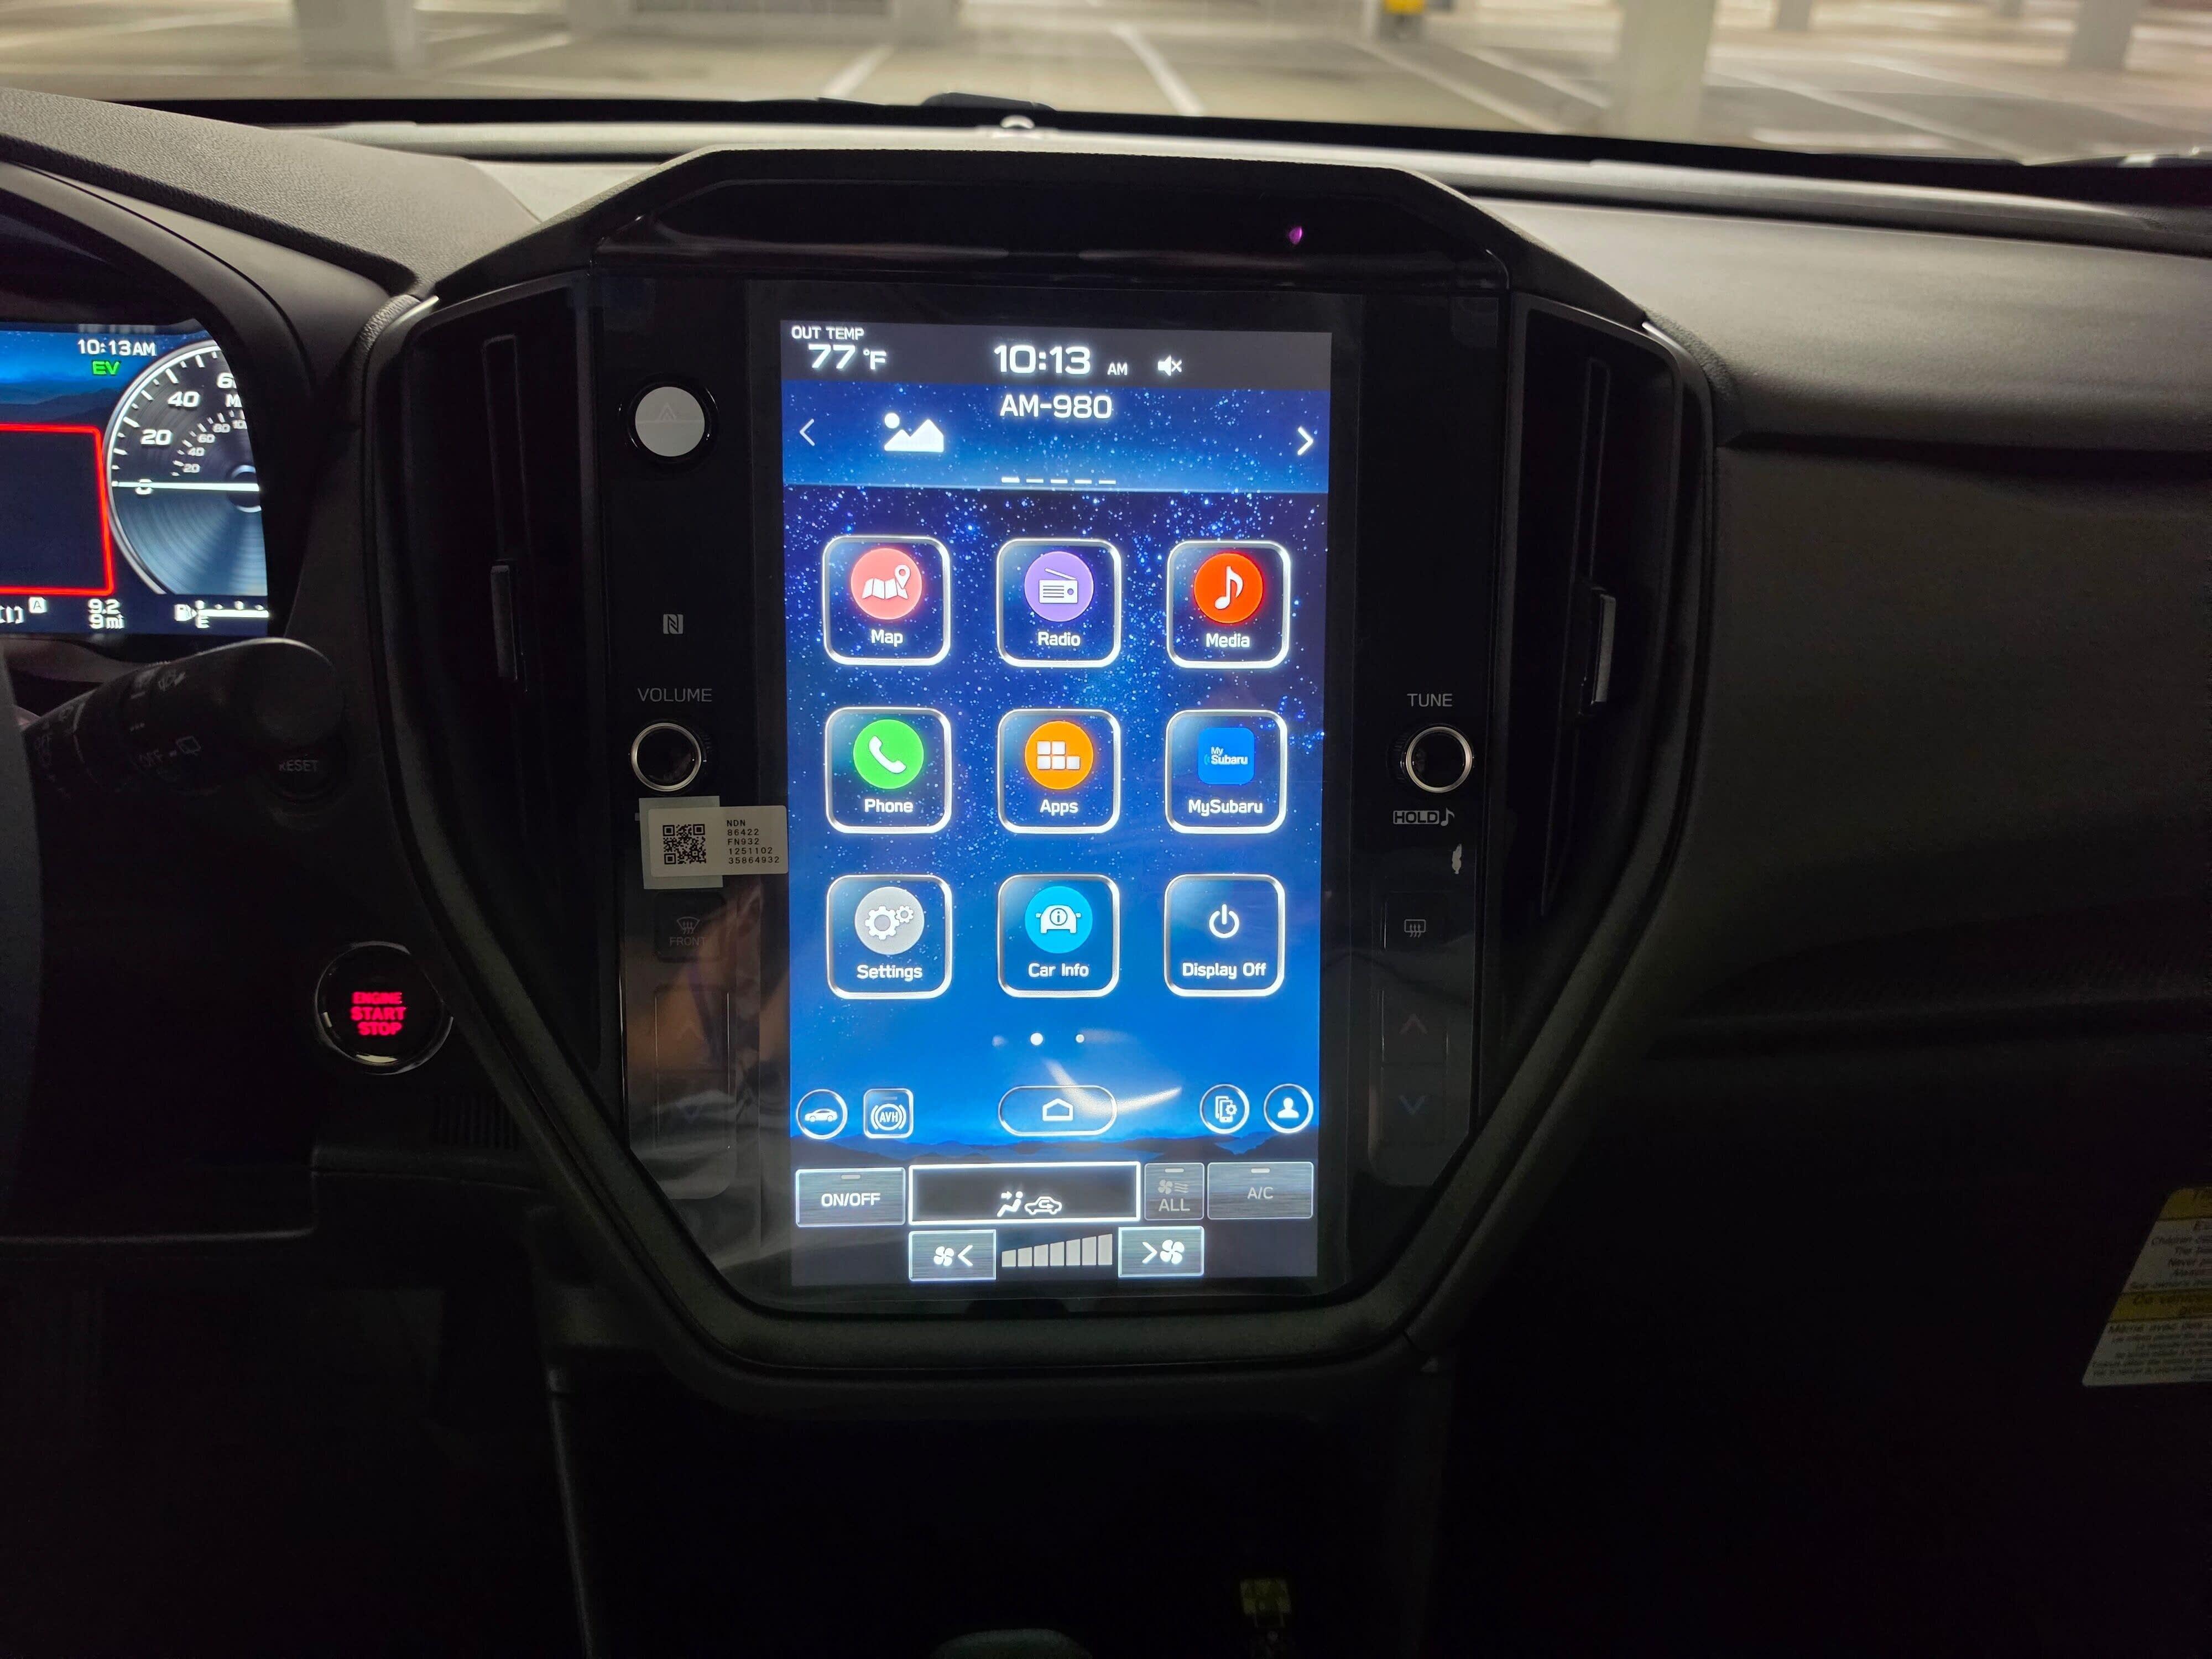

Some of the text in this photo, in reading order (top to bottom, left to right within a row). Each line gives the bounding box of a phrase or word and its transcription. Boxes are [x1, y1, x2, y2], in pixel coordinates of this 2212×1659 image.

[791, 325, 864, 340] OUT TEMP
[808, 343, 855, 369] 77
[994, 345, 1128, 375] 10:13 AM
[92, 361, 120, 374] EV
[216, 372, 237, 388] 6
[168, 390, 201, 408] 40
[999, 395, 1113, 419] AM-980
[141, 429, 173, 446] 20
[187, 447, 205, 457] 40
[182, 463, 200, 473] 20
[196, 617, 209, 628] E
[871, 629, 903, 646] Map
[1037, 631, 1081, 646] Radio
[1206, 633, 1250, 648] Media
[637, 688, 712, 702] VOLUME
[1407, 693, 1452, 707] TUNE
[1211, 747, 1223, 755] My
[278, 760, 319, 772] RESET
[1211, 755, 1248, 765] Subaru
[864, 799, 913, 813] Phone
[1040, 799, 1078, 816] Apps
[1188, 800, 1262, 816] MySubaru
[1393, 811, 1439, 824] HOLD
[729, 847, 773, 855] 1251102
[669, 937, 706, 946] FRONT
[857, 964, 923, 982] Settings
[1028, 962, 1089, 978] Car Info
[1182, 962, 1266, 979] Display Off
[352, 992, 403, 1004] ENGINE
[350, 1006, 406, 1020] START
[357, 1021, 403, 1035] STOP
[880, 1112, 899, 1123] AVH
[821, 1191, 880, 1208] ON/OFF
[1248, 1186, 1274, 1200] A/C
[1158, 1198, 1190, 1213] ALL
